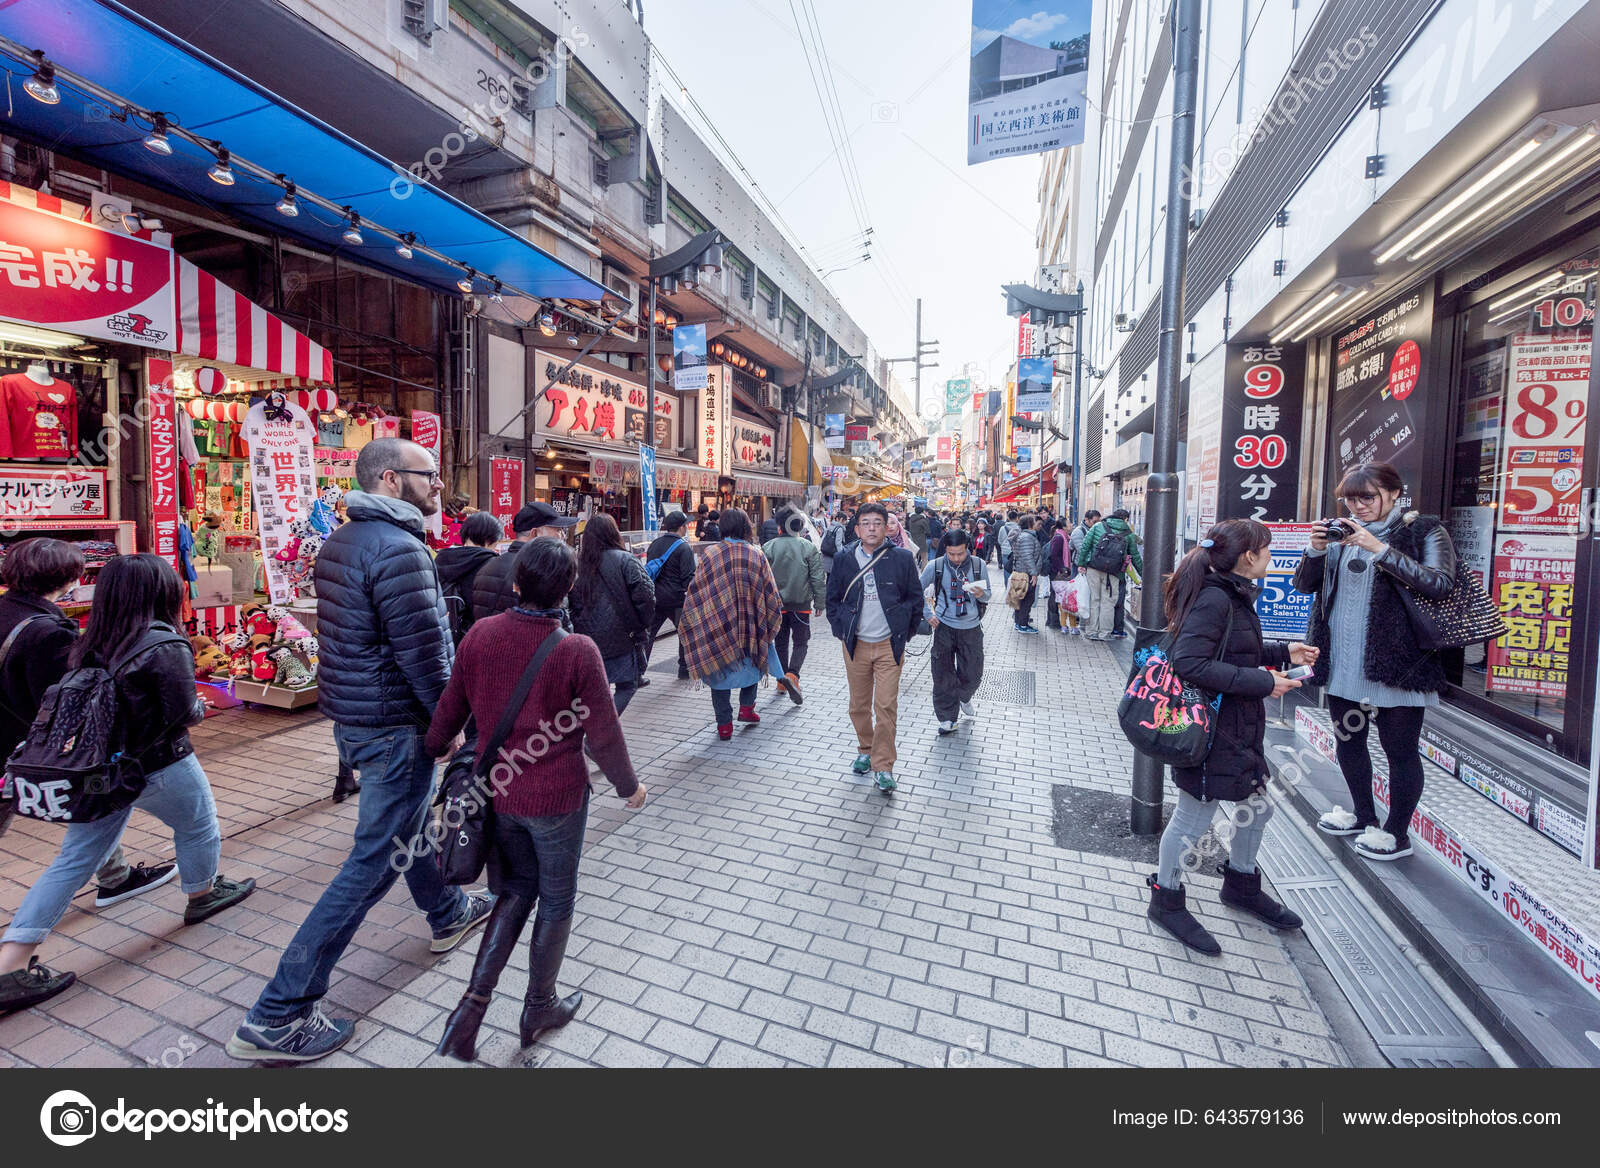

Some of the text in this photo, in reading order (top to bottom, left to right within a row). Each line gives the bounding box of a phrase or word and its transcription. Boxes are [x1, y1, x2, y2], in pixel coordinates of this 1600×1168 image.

[981, 105, 1080, 136] 国立西洋美術館
[0, 241, 134, 294] 完成!!
[545, 388, 616, 439] アメ横
[1390, 425, 1412, 447] VISA
[1287, 595, 1311, 604] OFF
[1491, 665, 1515, 678] TAX
[1517, 668, 1545, 680] FREE
